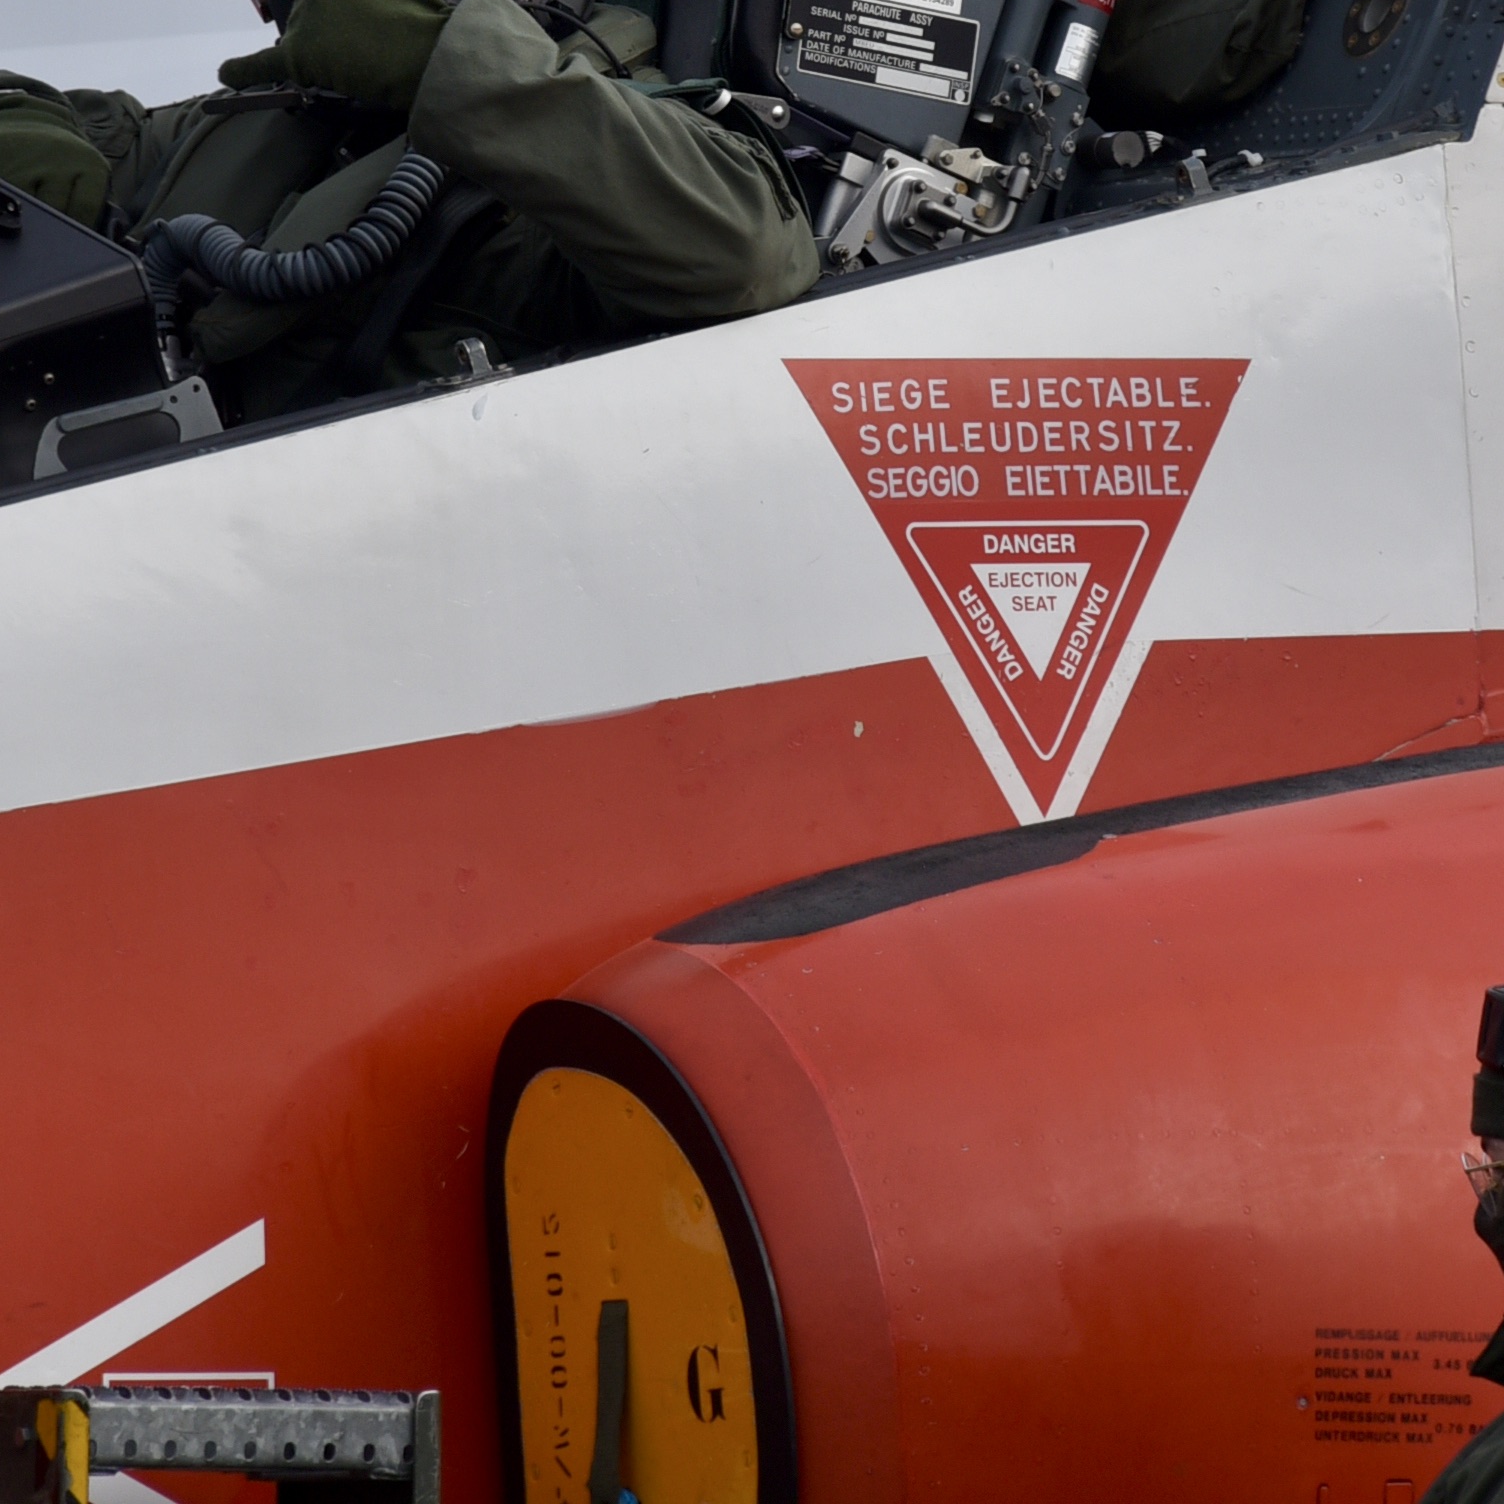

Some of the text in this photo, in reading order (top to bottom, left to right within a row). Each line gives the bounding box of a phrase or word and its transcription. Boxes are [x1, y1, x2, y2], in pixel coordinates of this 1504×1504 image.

[810, 6, 842, 21] SERIAL
[851, 0, 934, 27] PARACHUTE ASSY
[807, 29, 832, 41] PART
[843, 24, 870, 37] ISSUE
[804, 51, 877, 74] MODIFICATIONS
[806, 40, 916, 70] DATE OF MANUFACTURE
[831, 376, 1211, 413] SIEGE EJECTABLE.
[859, 419, 1194, 455] SCHLEUDERSITZ.
[867, 464, 1190, 498] SEGGIO EIETTABILE.
[983, 533, 1076, 554] DANGER
[988, 571, 1078, 588] EJECTION
[1012, 595, 1057, 612] SEAT
[958, 584, 1024, 682] DANGER
[1056, 582, 1110, 680] DANGER
[1315, 1328, 1400, 1341] REMPLISSAGE
[1315, 1348, 1420, 1361] PRESSION MAX
[1315, 1367, 1392, 1379] DRUCK MAX
[687, 1343, 727, 1423] G
[1315, 1391, 1371, 1404] VIDANGE
[1389, 1392, 1472, 1406] ENTLEERUNG
[1315, 1410, 1427, 1423] DEPRESSION MAX
[1315, 1430, 1433, 1443] UNTERDRUCK MAX
